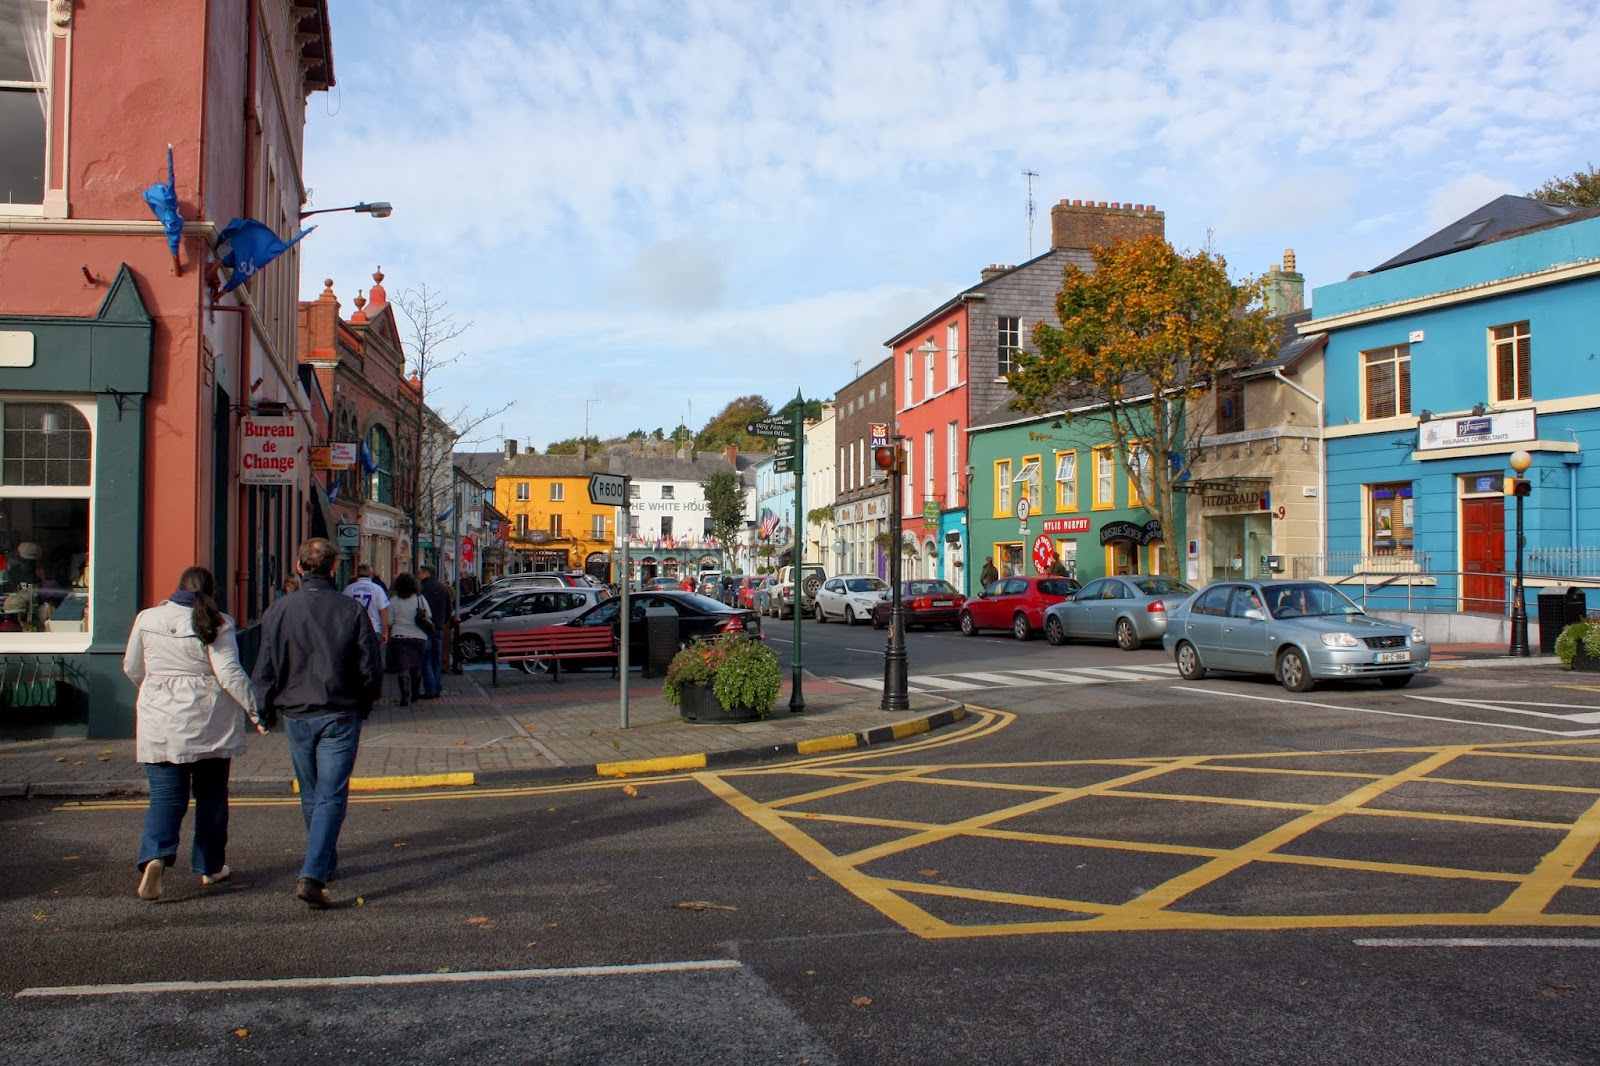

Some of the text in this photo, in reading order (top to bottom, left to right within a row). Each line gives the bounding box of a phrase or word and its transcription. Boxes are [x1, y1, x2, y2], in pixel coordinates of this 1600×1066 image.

[244, 421, 295, 437] Bureau
[1442, 433, 1509, 445] INSURANCE CONSULTANTS
[262, 441, 276, 452] de
[243, 453, 295, 472] Change
[600, 482, 623, 497] R600
[1202, 493, 1259, 506] FITZGERALD
[631, 502, 711, 512] HE WHITE HOUS
[1043, 519, 1088, 531] MYLIE MURPHY
[1101, 524, 1142, 542] KINSALE SILVER
